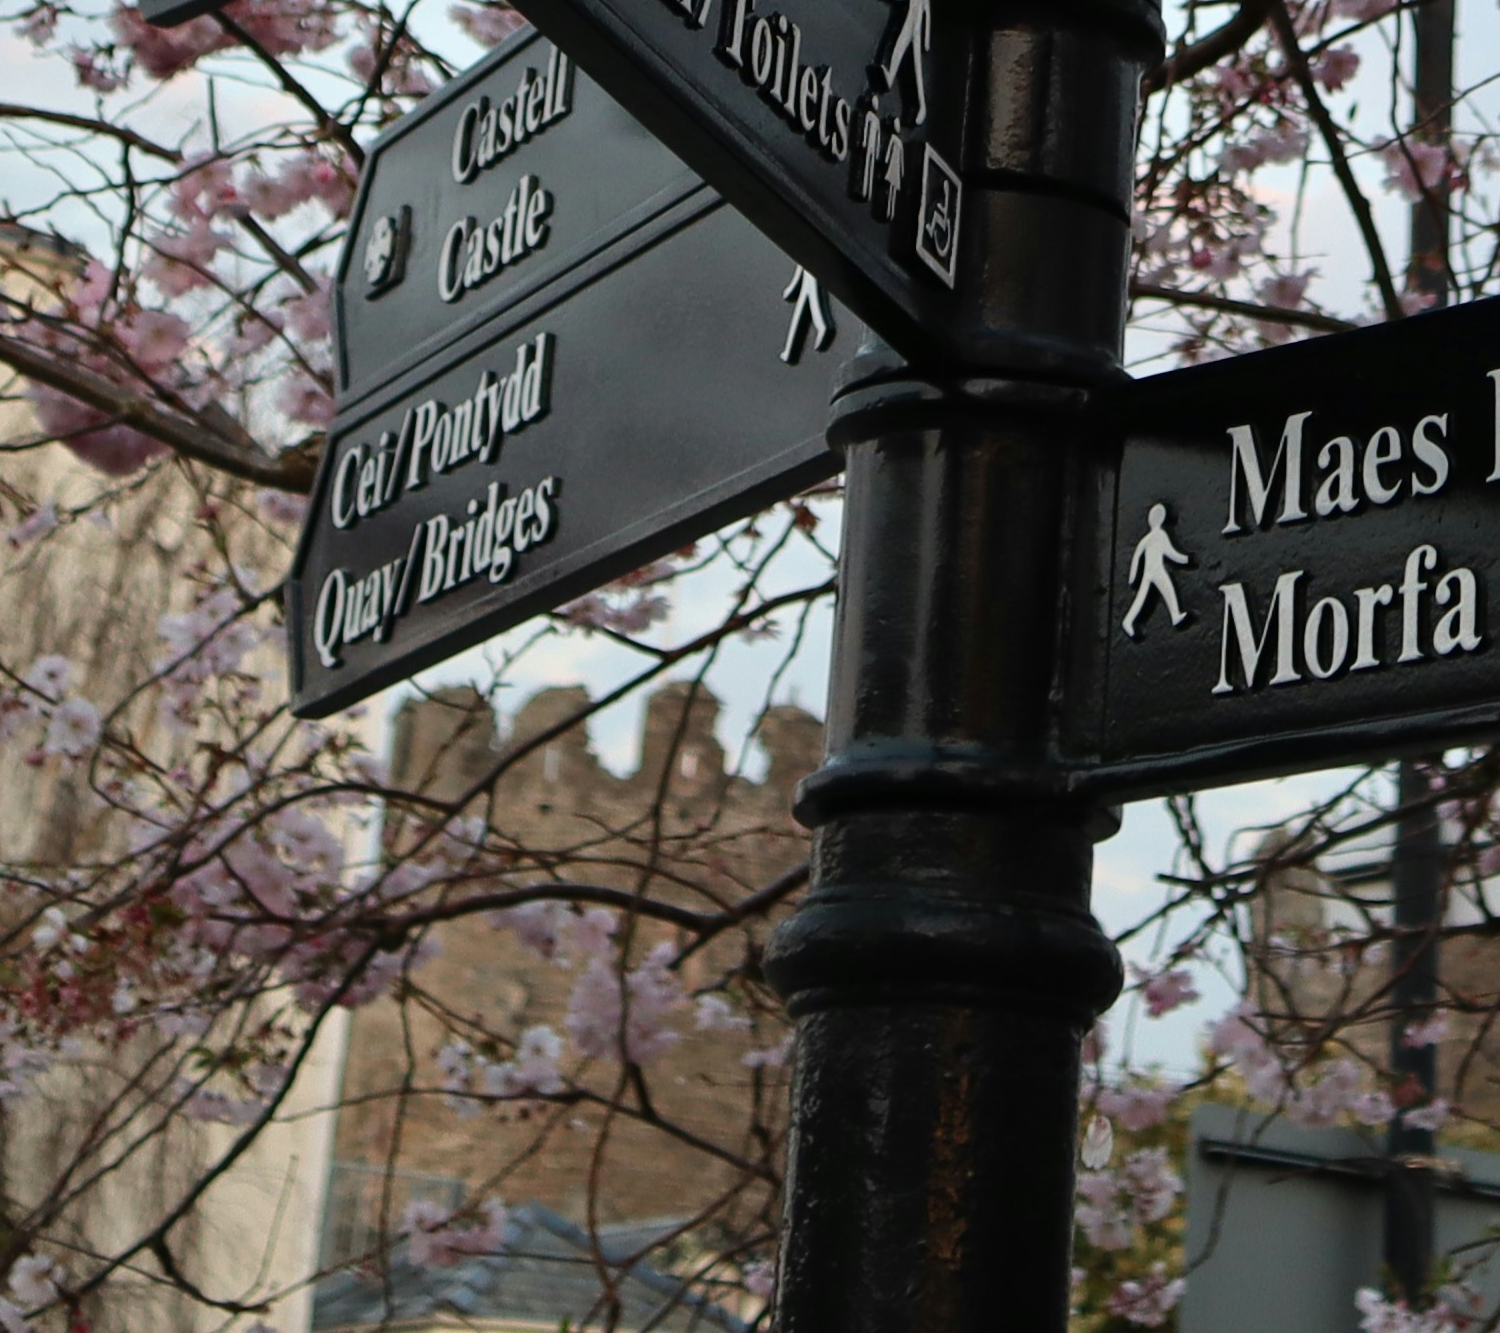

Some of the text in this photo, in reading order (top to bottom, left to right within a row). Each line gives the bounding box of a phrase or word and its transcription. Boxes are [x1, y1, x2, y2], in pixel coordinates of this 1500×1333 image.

[451, 44, 567, 183] Castell
[437, 174, 547, 303] Castle
[1223, 409, 1451, 534] Maes
[1211, 546, 1482, 695] Morfa
